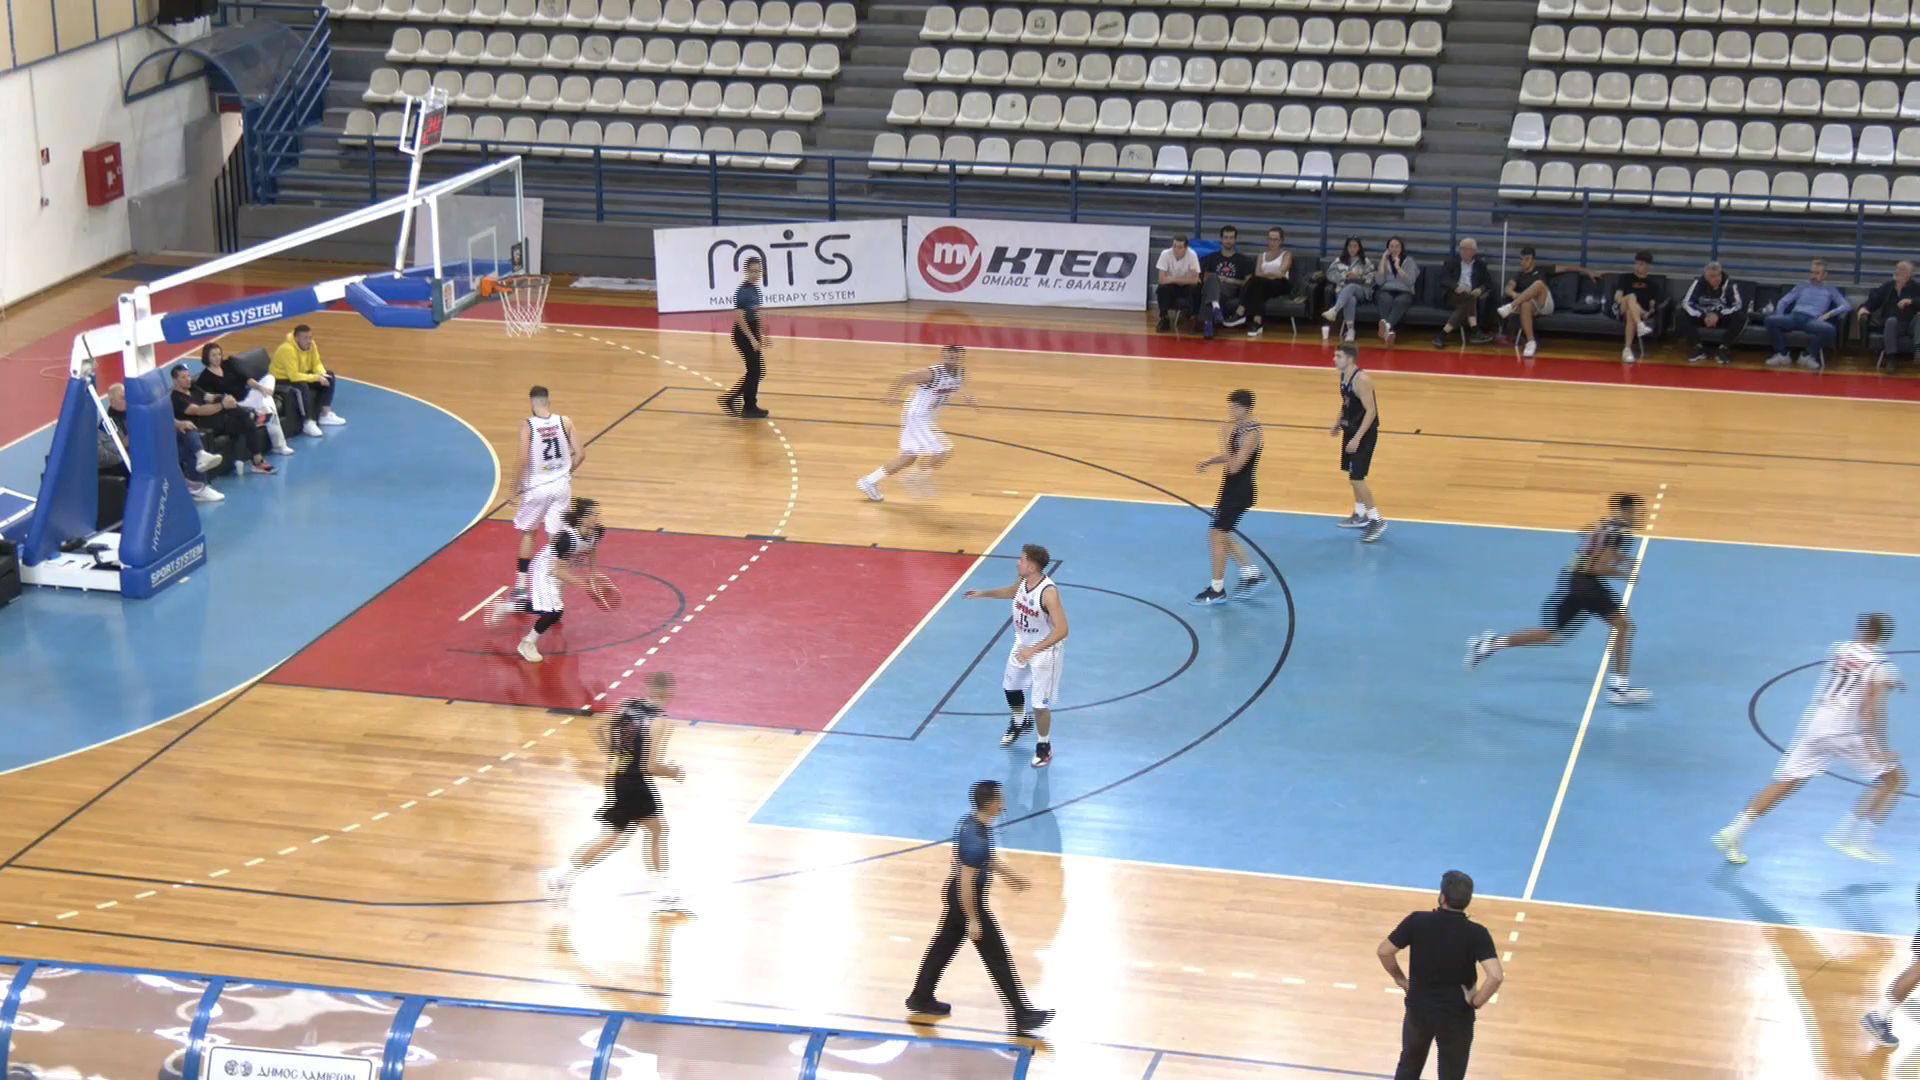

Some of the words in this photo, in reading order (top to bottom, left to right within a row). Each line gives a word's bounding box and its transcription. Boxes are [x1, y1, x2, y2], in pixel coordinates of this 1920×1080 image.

[982, 275, 1031, 288] ΟΜΙΛΟΣ
[1065, 279, 1127, 293] ΘΑΛΑΣΣΗ
[709, 296, 735, 306] MAN
[763, 293, 807, 303] HERAPY
[813, 290, 856, 301] SYSTEM
[187, 312, 230, 332] SPORT
[231, 300, 283, 325] SYSTEM
[541, 437, 562, 461] 21
[152, 478, 169, 552] HYDROPLAY
